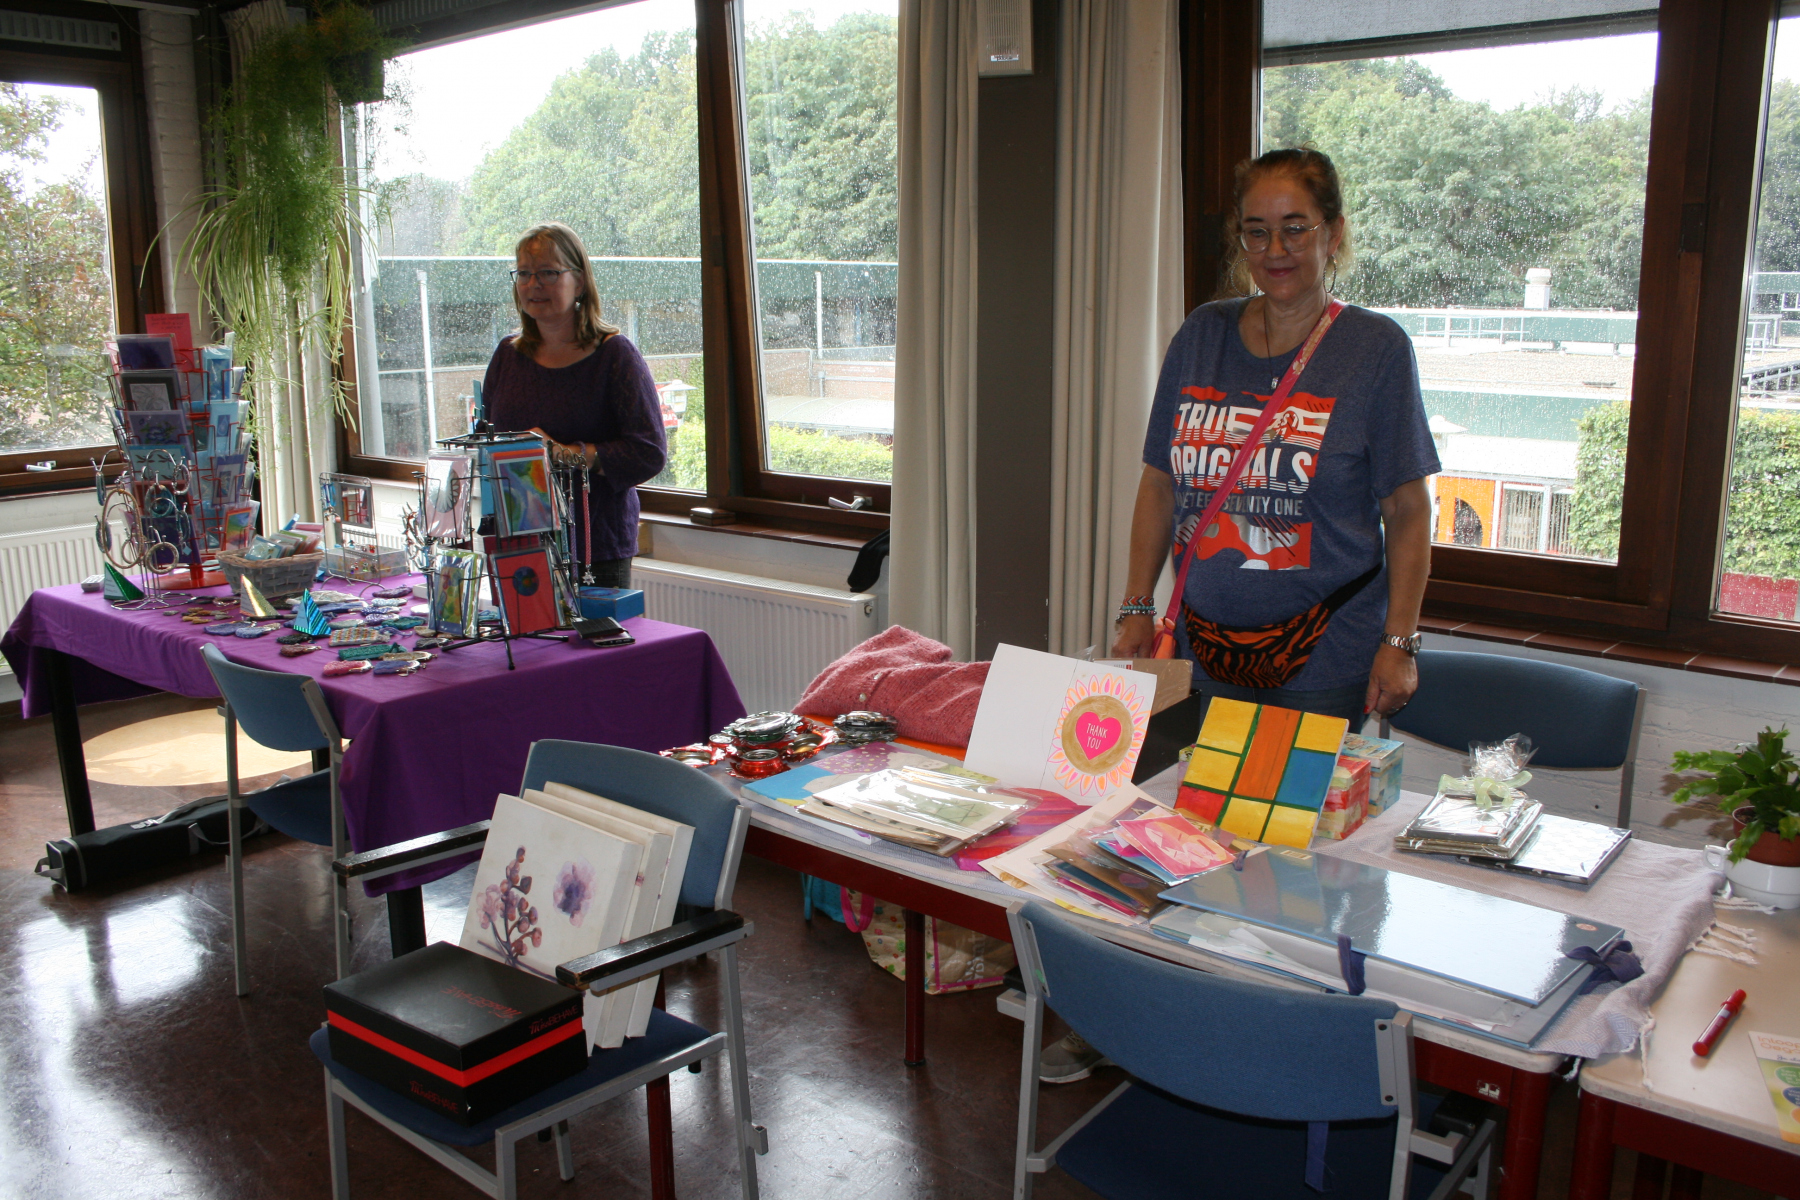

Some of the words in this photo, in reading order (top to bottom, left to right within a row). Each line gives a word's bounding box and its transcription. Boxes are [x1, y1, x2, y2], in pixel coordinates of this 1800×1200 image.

[1274, 497, 1303, 516] ONE
[1086, 723, 1108, 738] THANK
[1086, 736, 1102, 749] YOU
